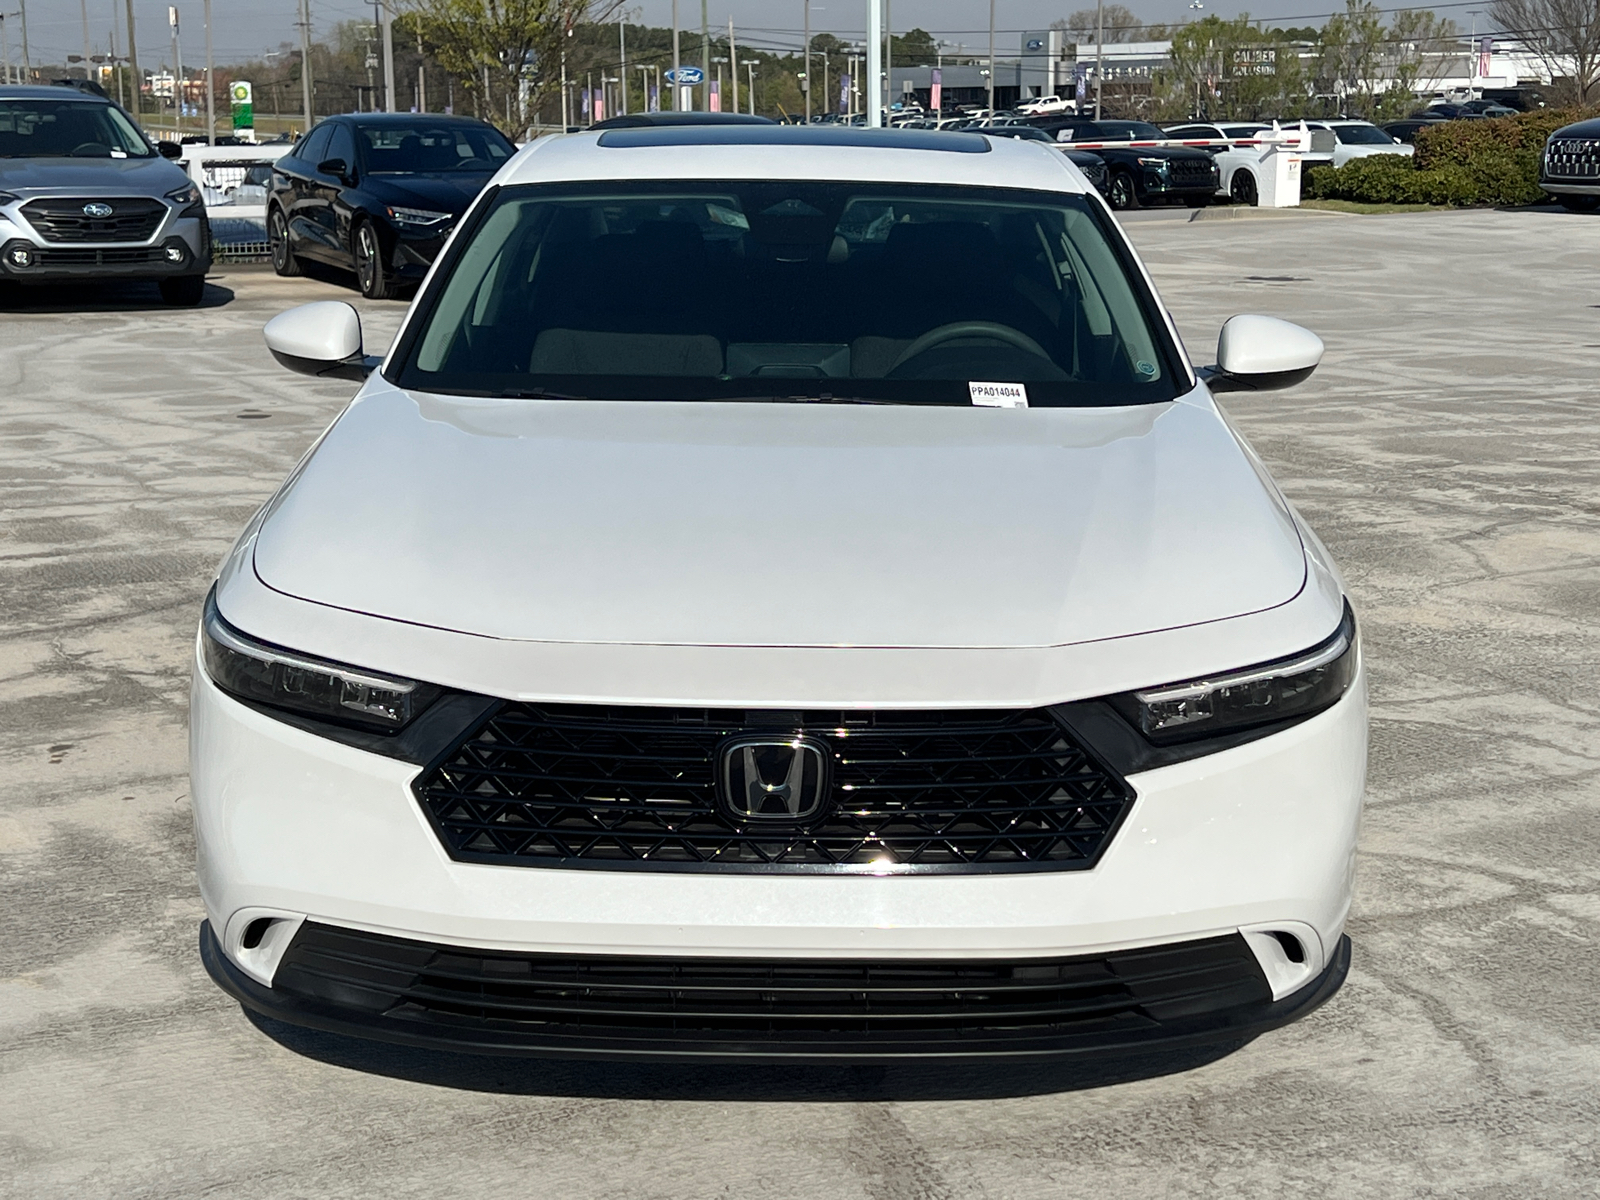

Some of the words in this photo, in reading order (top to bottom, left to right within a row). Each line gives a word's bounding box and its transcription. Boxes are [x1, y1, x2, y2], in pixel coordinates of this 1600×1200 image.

[1233, 50, 1276, 62] CALIBER
[678, 69, 701, 82] Ford
[971, 386, 1021, 397] PPA014044
